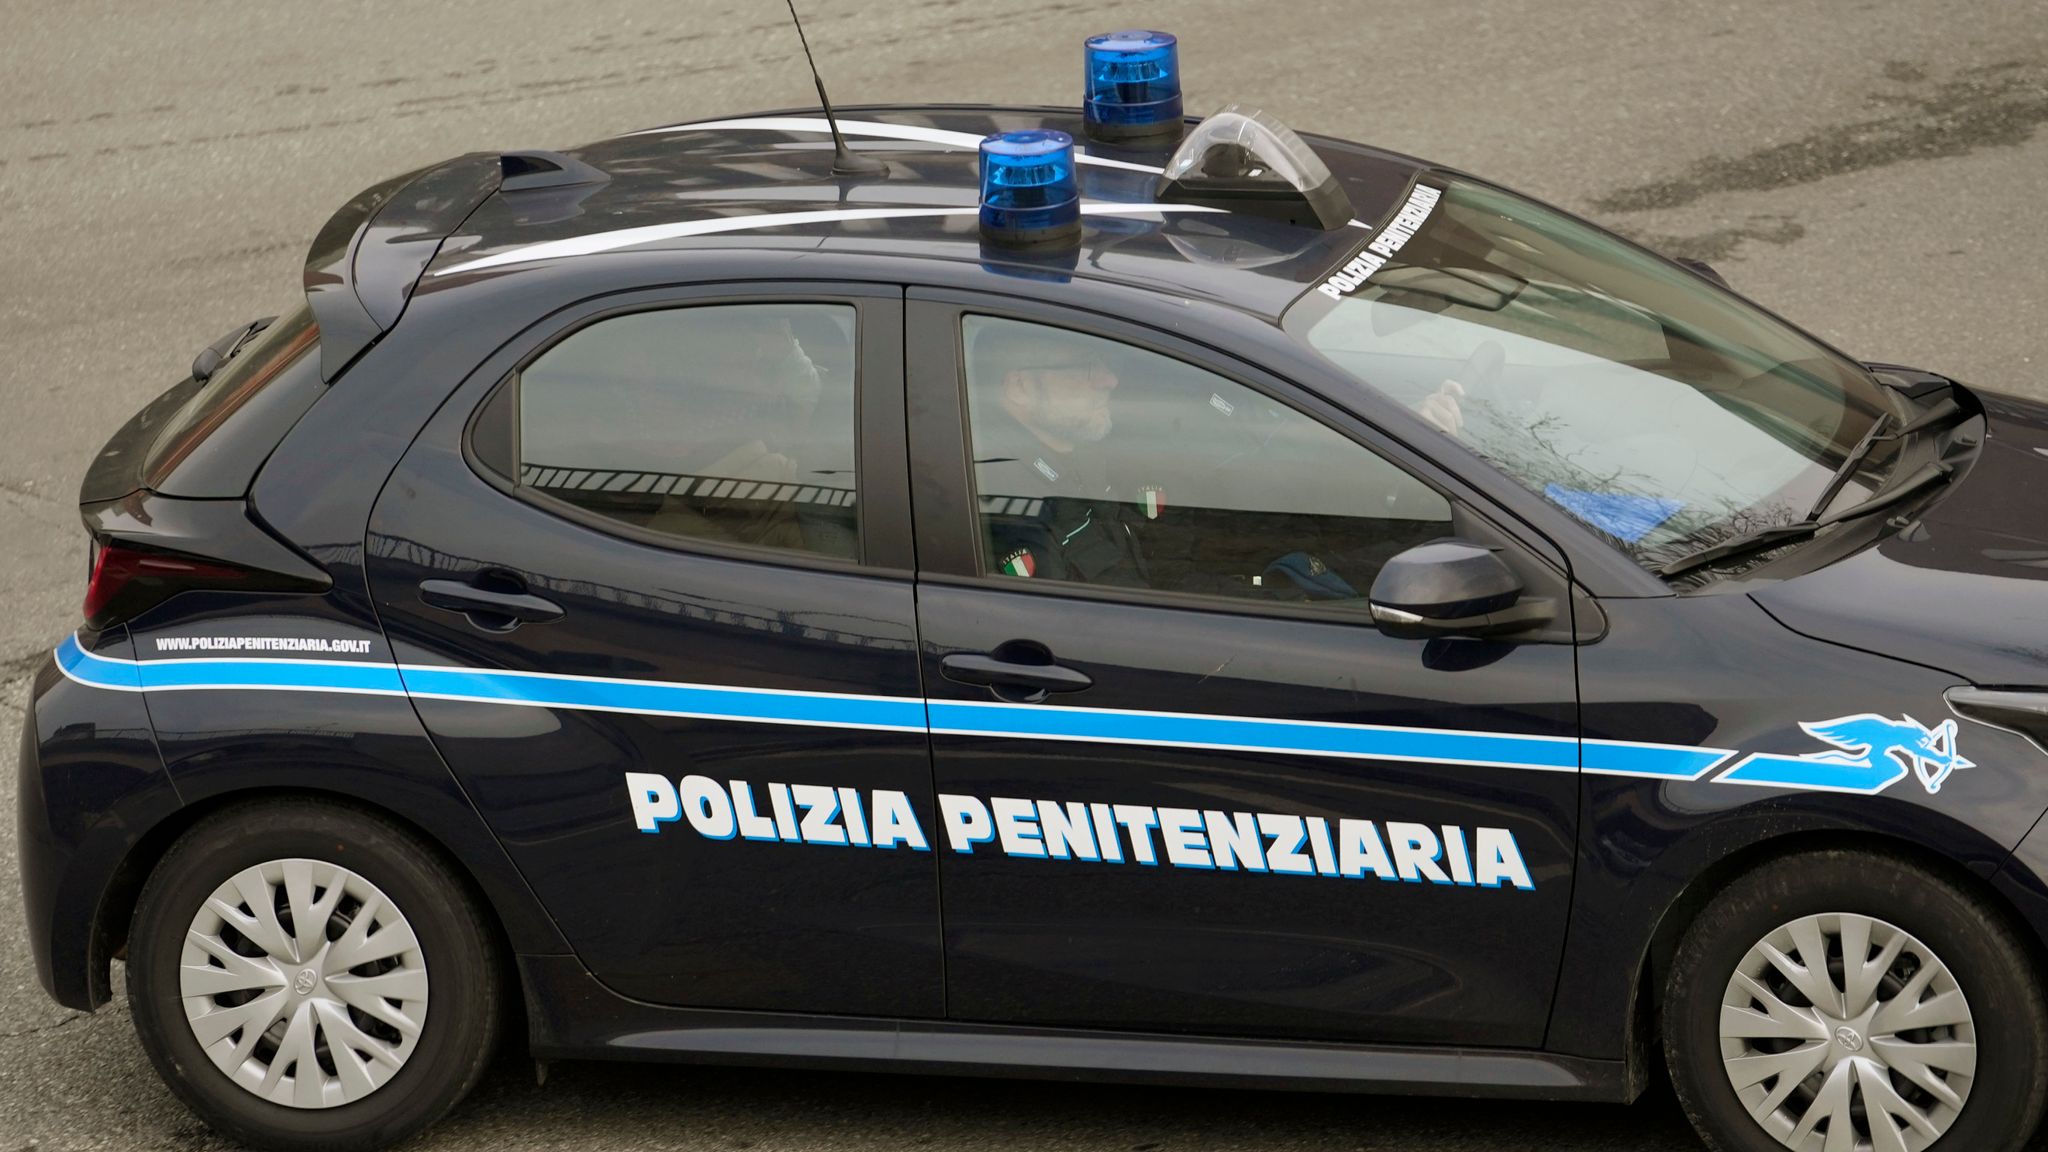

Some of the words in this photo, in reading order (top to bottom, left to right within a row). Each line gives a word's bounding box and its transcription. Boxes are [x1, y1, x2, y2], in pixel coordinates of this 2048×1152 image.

[1317, 251, 1387, 300] POLIZIA
[1368, 183, 1442, 258] PENITENZIARIA
[156, 637, 371, 653] WWW.POLIZIAPENITENZIARIA.GOV.IT
[625, 772, 931, 851] POLIZIA
[938, 793, 1535, 890] PENITENZIARIA
